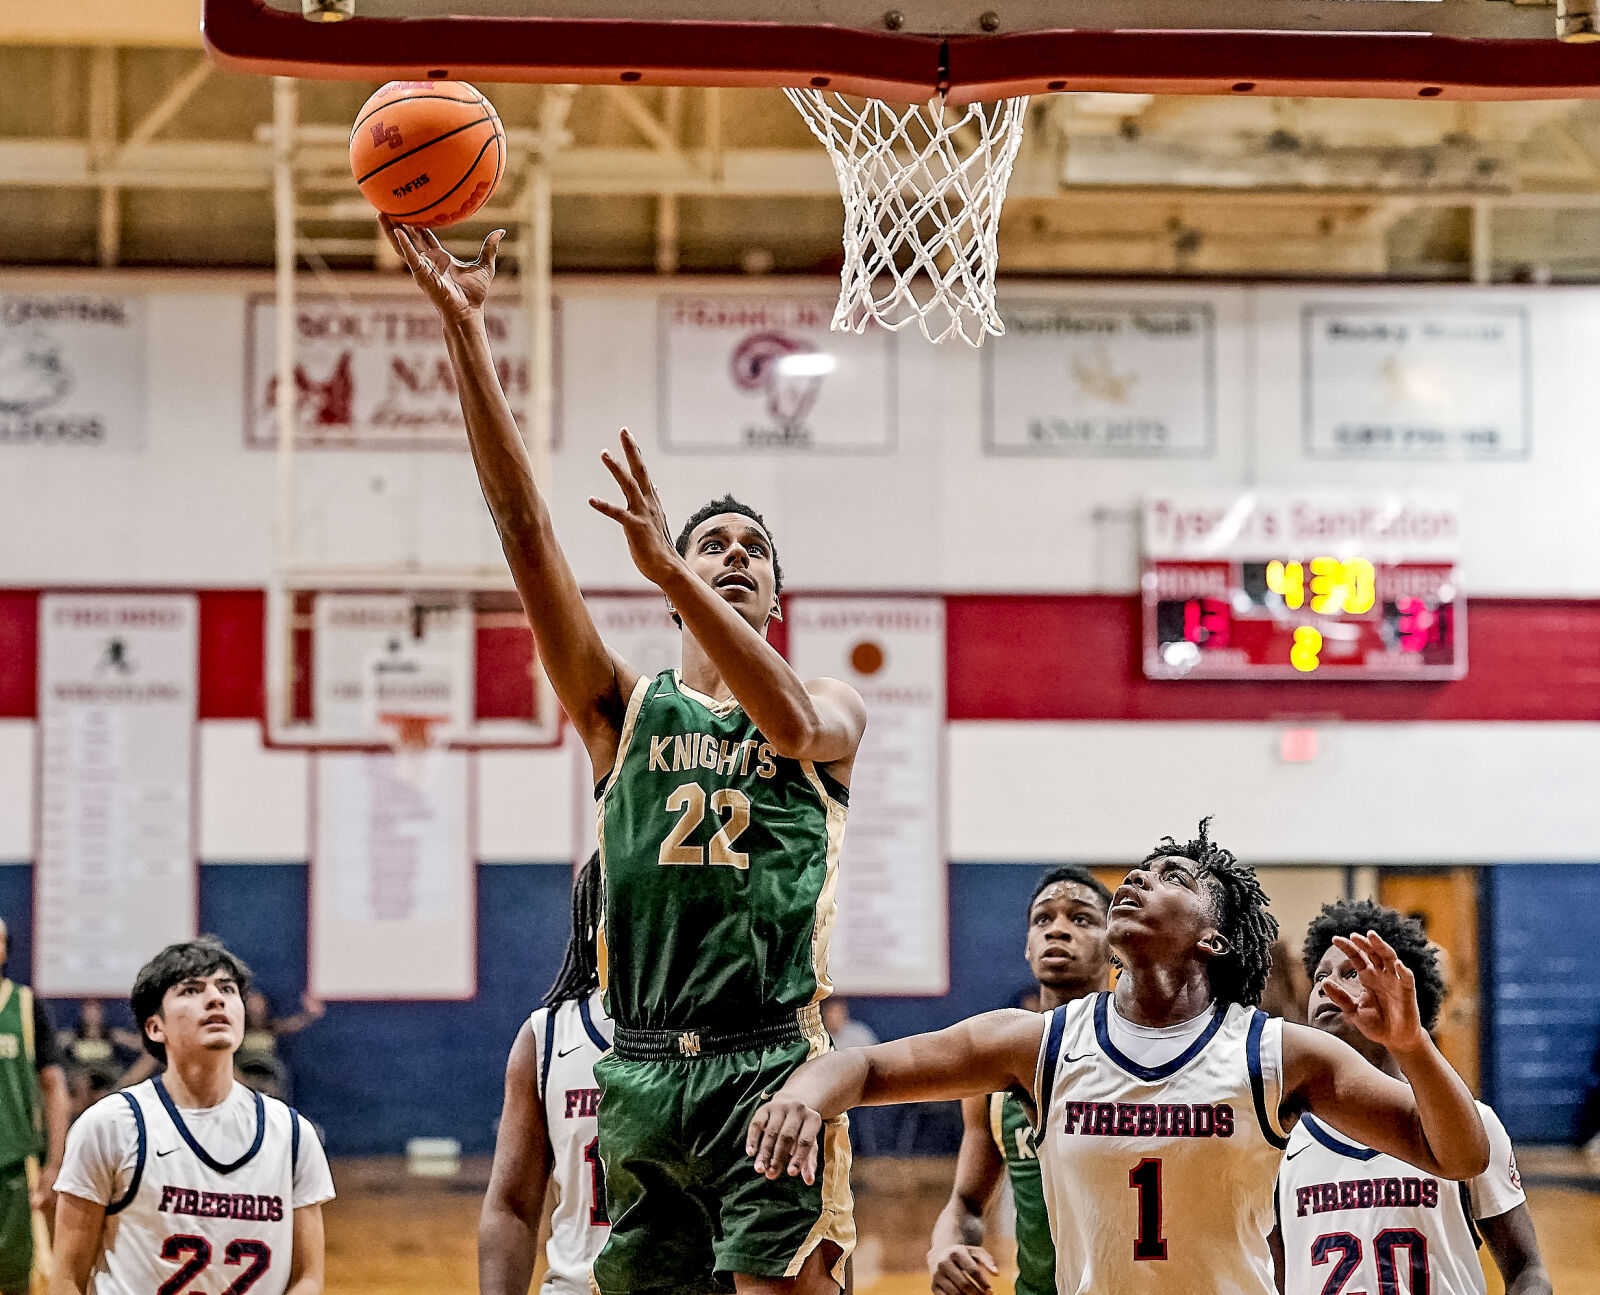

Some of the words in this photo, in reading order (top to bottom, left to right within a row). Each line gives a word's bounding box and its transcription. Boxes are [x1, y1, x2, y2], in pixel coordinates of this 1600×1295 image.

[399, 173, 431, 196] NFHS
[297, 311, 506, 340] SOUTHEN
[388, 354, 530, 394] NAH
[649, 733, 778, 778] KNIGHTS
[658, 782, 750, 869] 22
[1064, 1101, 1235, 1137] FIREBIRDS
[158, 1185, 283, 1222] FIREBIRDS
[1129, 1157, 1168, 1261] 1
[1296, 1176, 1438, 1218] FIREBIRDS
[157, 1233, 271, 1295] 22
[1311, 1227, 1430, 1295] 20
